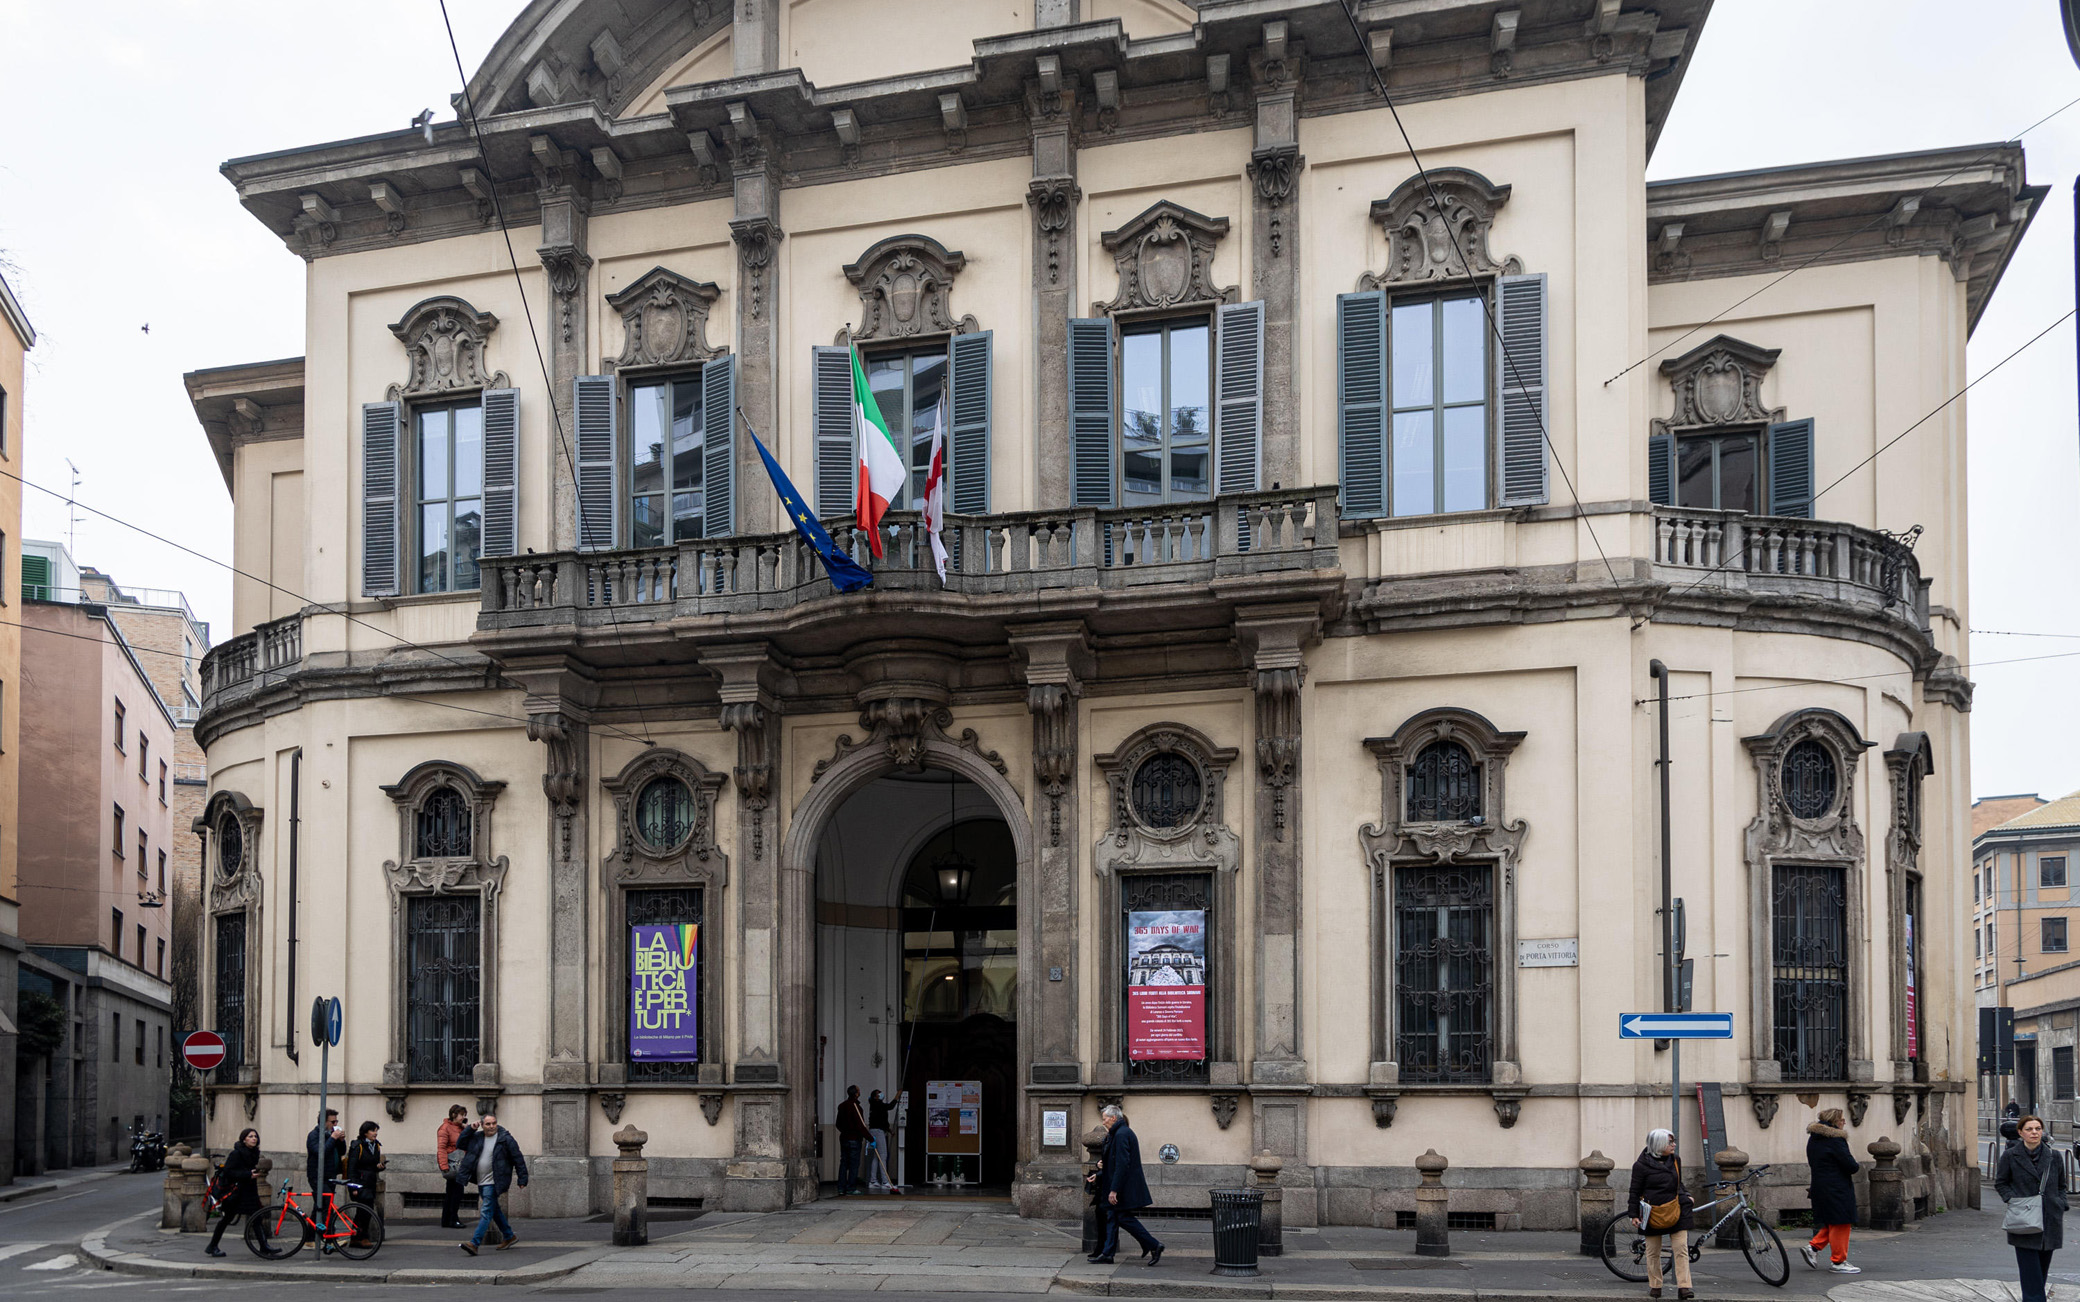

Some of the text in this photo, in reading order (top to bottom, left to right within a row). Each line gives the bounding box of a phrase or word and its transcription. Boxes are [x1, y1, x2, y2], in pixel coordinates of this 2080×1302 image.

[1134, 925, 1199, 935] 365 DAYS OF WAR
[635, 932, 668, 951] LA
[635, 951, 695, 970] BIBLIO
[1526, 952, 1547, 960] PORTA
[1548, 951, 1577, 960] VITTORIA
[635, 970, 686, 990] TECA
[635, 987, 688, 1010] È PER
